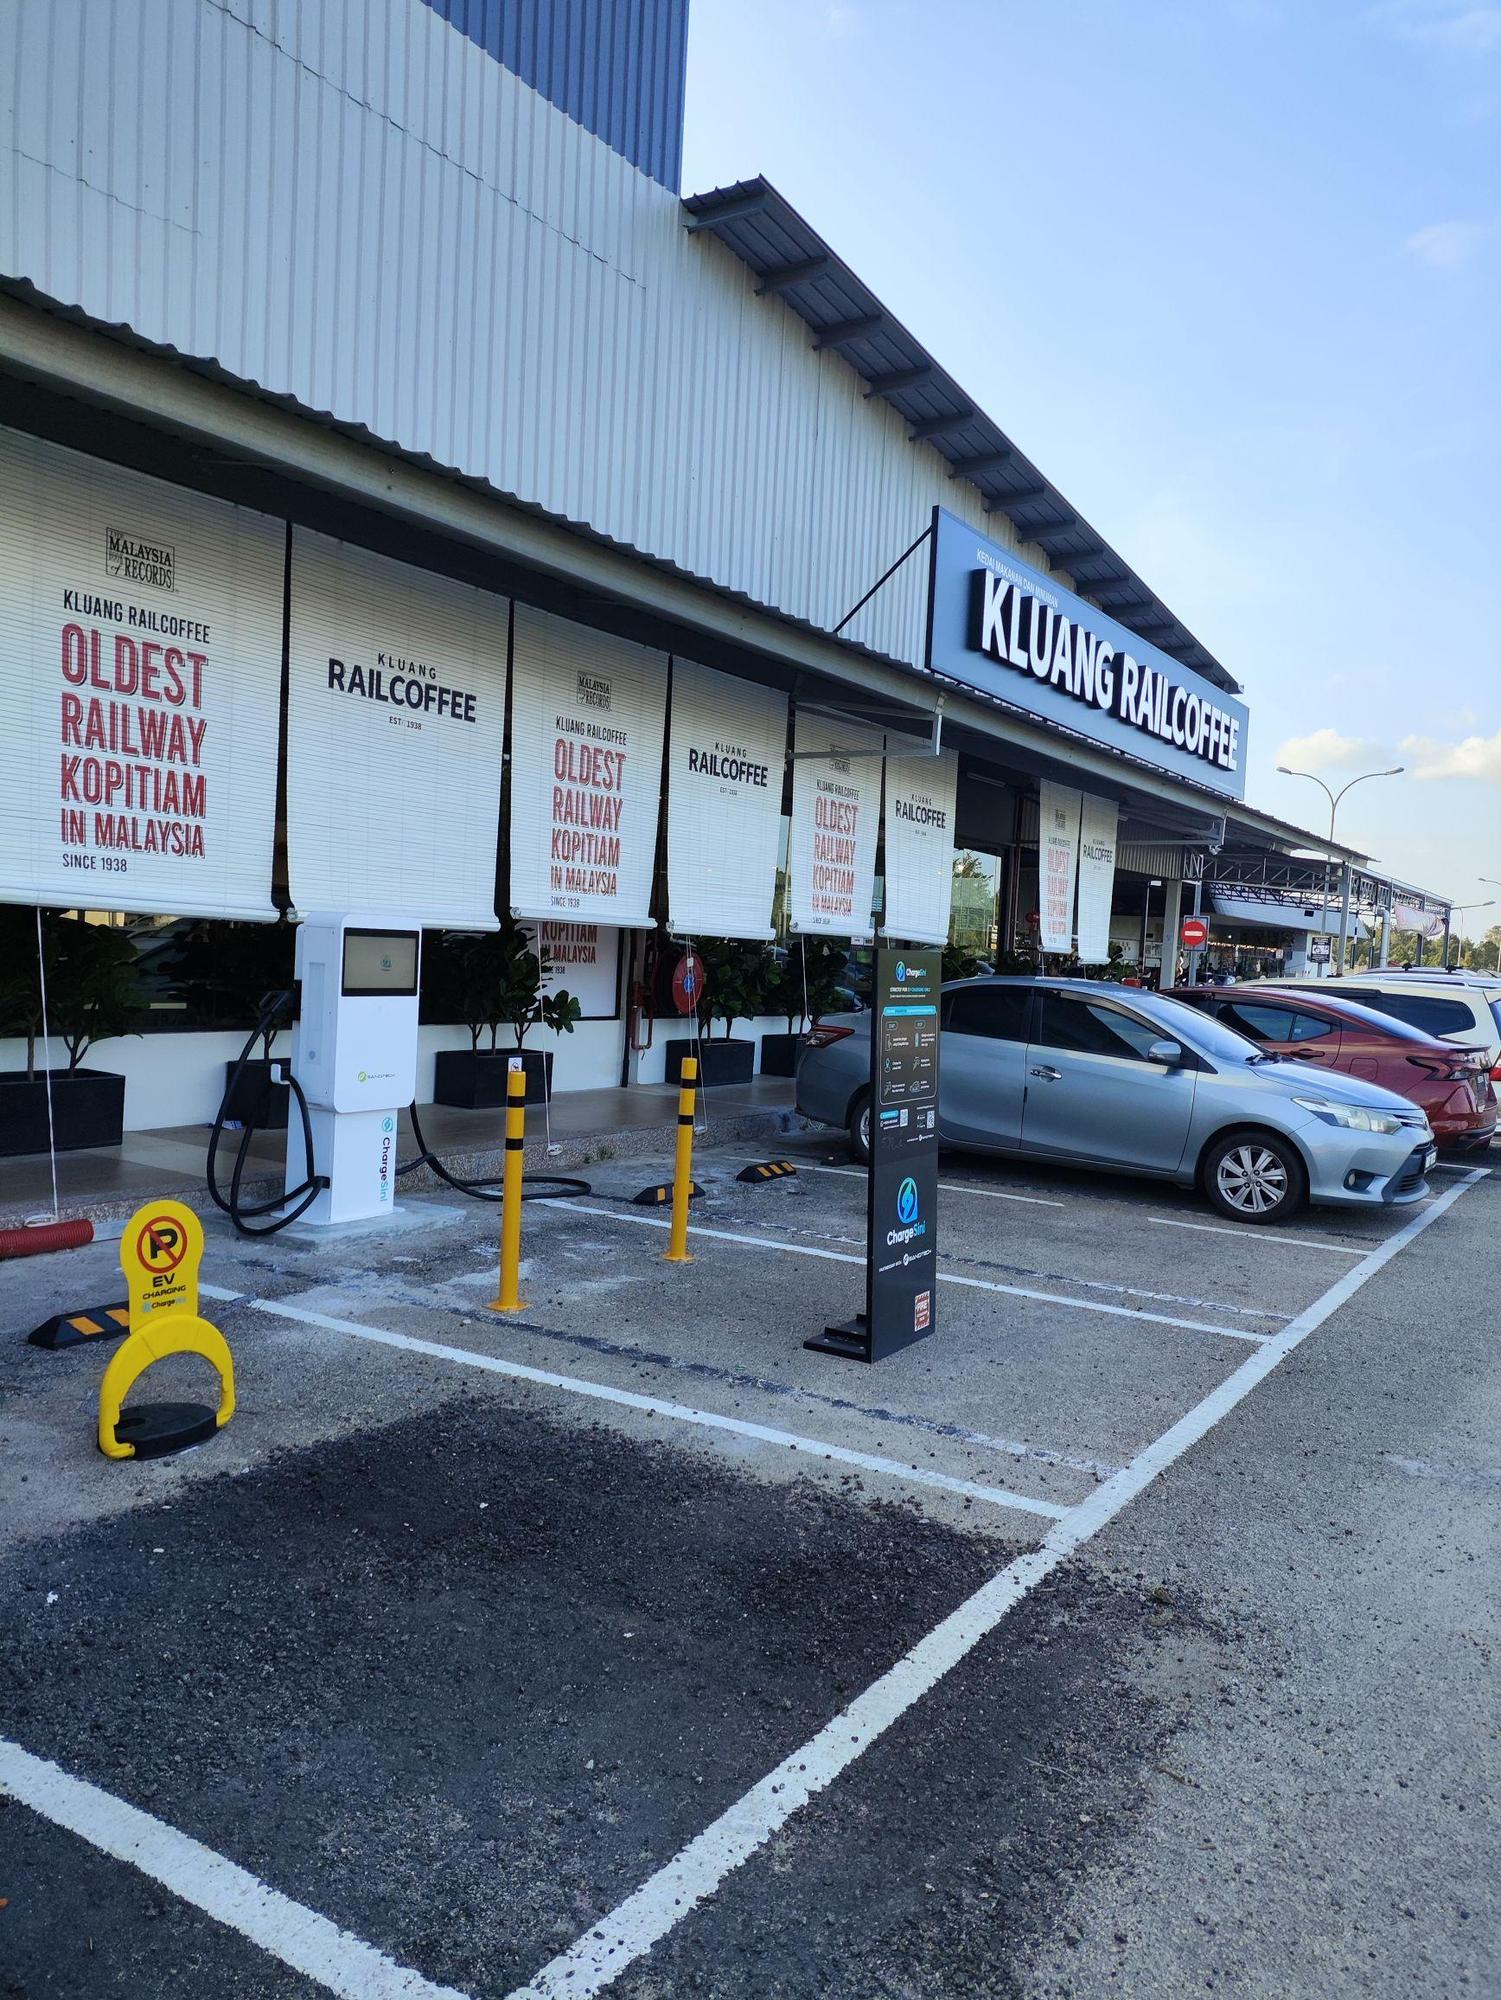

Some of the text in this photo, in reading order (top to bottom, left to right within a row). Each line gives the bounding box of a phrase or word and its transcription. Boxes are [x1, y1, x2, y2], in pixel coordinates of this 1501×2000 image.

[109, 535, 172, 567] MALAYSIA
[977, 548, 995, 569] KEDAI
[124, 556, 172, 589] RECORDS
[63, 589, 210, 644] KLUANG RAILCOFFEE
[61, 623, 208, 710] OLDEST
[378, 652, 437, 680] KLUANG
[980, 567, 1240, 771] KLUANG RAILCOFFEE
[328, 657, 477, 723] RAILCOFFEE
[579, 676, 610, 694] MALAYSIA
[586, 690, 610, 710] RECORDS
[61, 692, 207, 766] RAILWAY
[406, 720, 422, 731] 1938
[555, 715, 628, 746] KLUANG RAILCOFFEE
[554, 738, 626, 793] OLDEST
[715, 742, 747, 758] KLUANG
[688, 747, 768, 787] RAILCOFFEE
[61, 753, 207, 819] KOPITIAM
[553, 785, 623, 833] RAILWAY
[815, 795, 858, 836] OLDEST
[895, 799, 946, 829] RAILCOFFEE
[61, 808, 206, 858] IN MALAYSIA
[551, 827, 620, 869] KOPITIAM
[814, 832, 856, 866] RAILWAY
[62, 853, 127, 873] SINCE 1938
[1082, 844, 1113, 864] RAILCOFFEE
[550, 865, 617, 897] IN MALAYSIA
[812, 863, 854, 896] KOPITIAM
[550, 895, 566, 908] SINCE
[542, 921, 597, 944] KOPITIAM
[553, 945, 596, 964] MALAYSIA
[379, 1136, 391, 1202] ChargeSini
[887, 1220, 926, 1246] ChargeSini
[142, 1285, 186, 1300] CHARGING
[153, 1272, 175, 1288] EV
